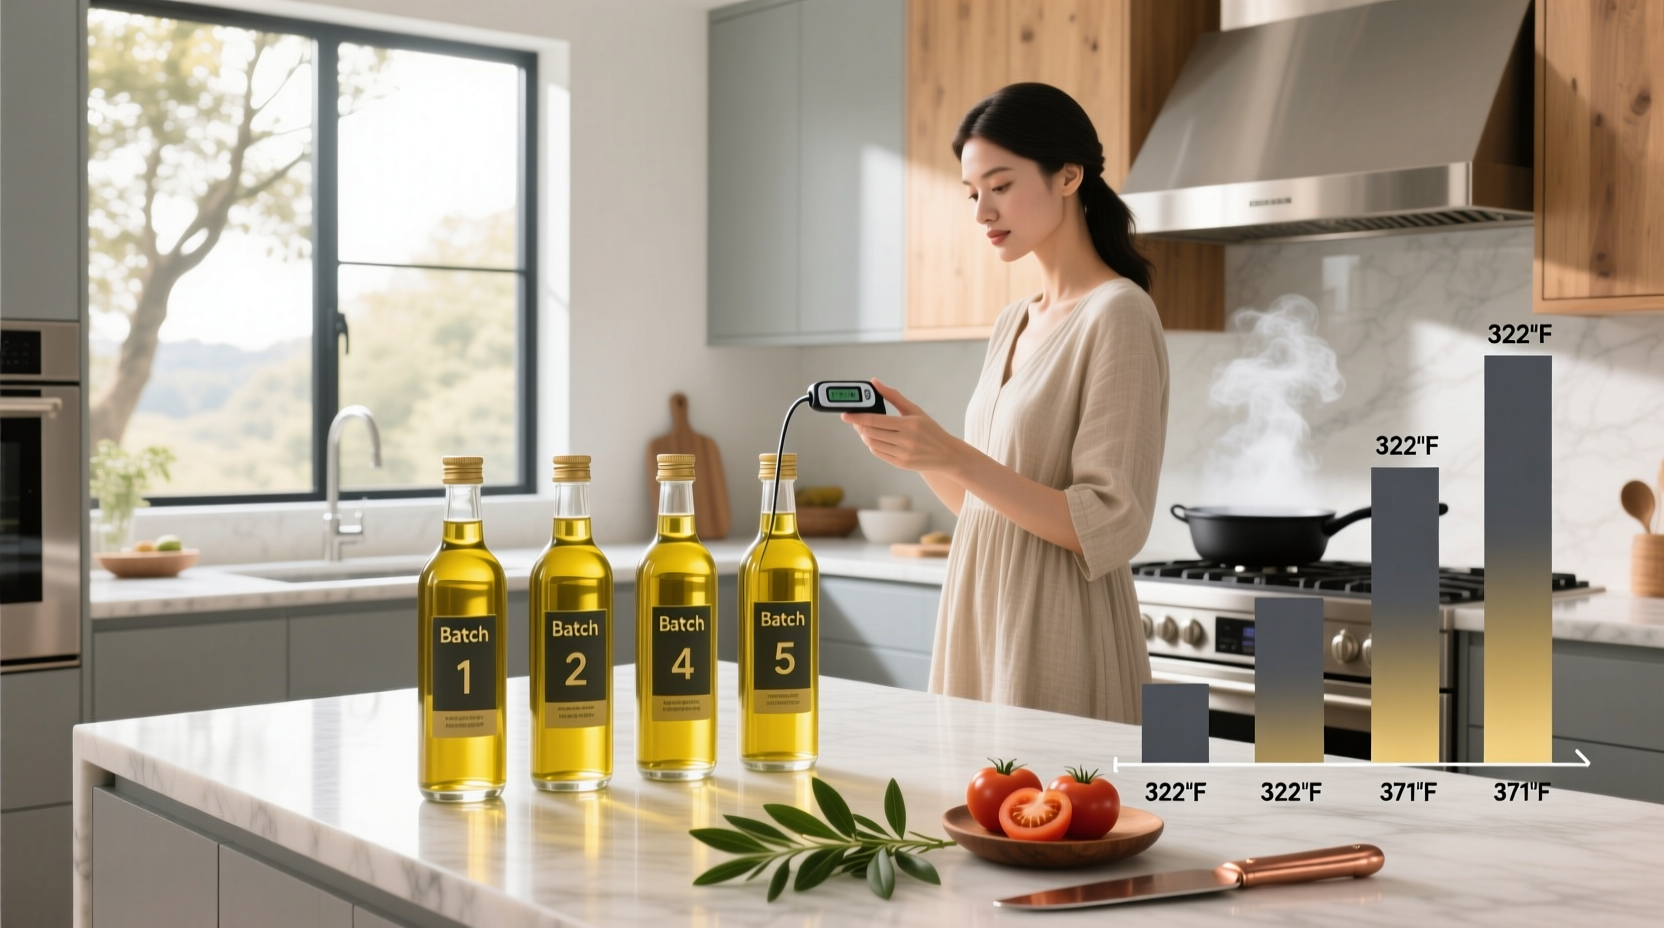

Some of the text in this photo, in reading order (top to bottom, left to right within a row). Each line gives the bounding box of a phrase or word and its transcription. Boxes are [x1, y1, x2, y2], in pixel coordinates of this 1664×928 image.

[551, 618, 600, 638] Batch
[659, 614, 705, 633] Batch
[760, 610, 806, 628] Batch
[440, 624, 489, 644] Batch
[564, 651, 588, 686] 2
[671, 647, 695, 681] 4
[774, 641, 796, 676] 5
[456, 659, 471, 695] 1
